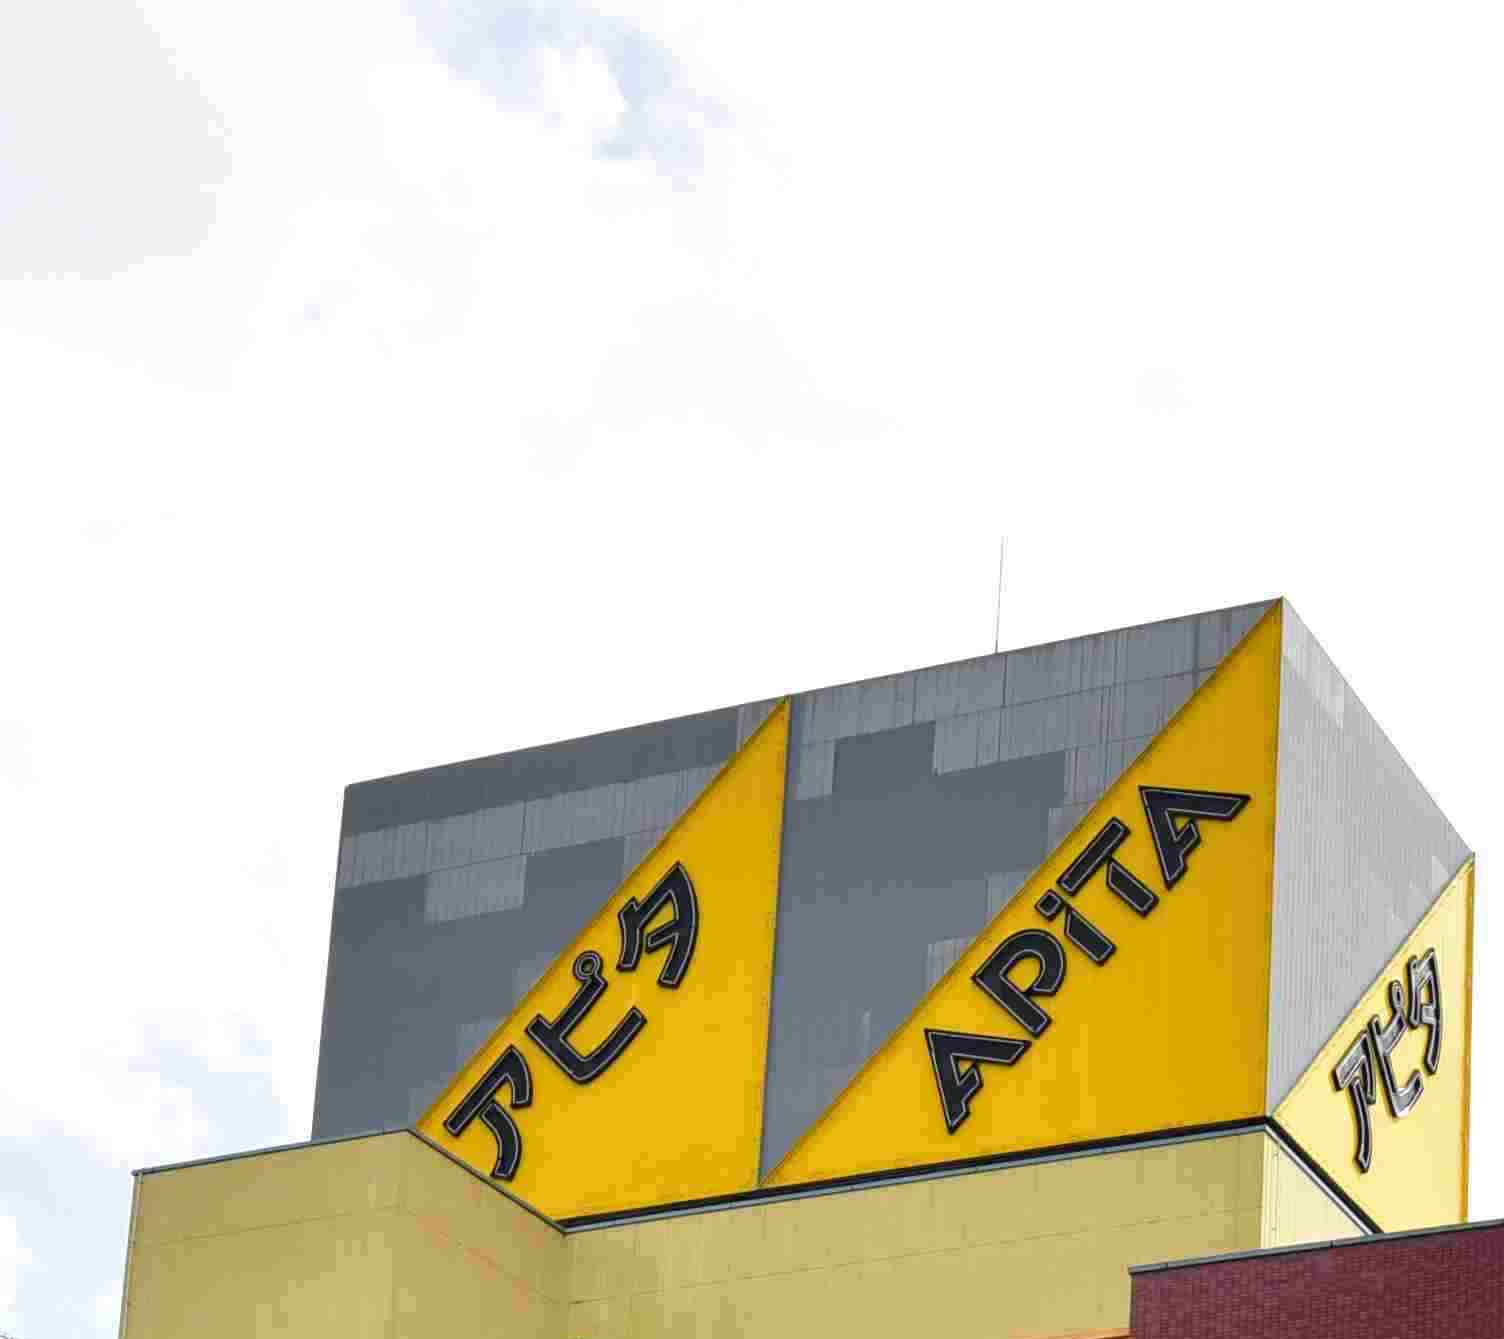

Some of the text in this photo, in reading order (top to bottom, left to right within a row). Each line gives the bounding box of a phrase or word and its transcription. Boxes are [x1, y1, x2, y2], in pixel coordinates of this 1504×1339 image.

[443, 860, 700, 1180] アピタ
[1329, 946, 1444, 1173] アピタ
